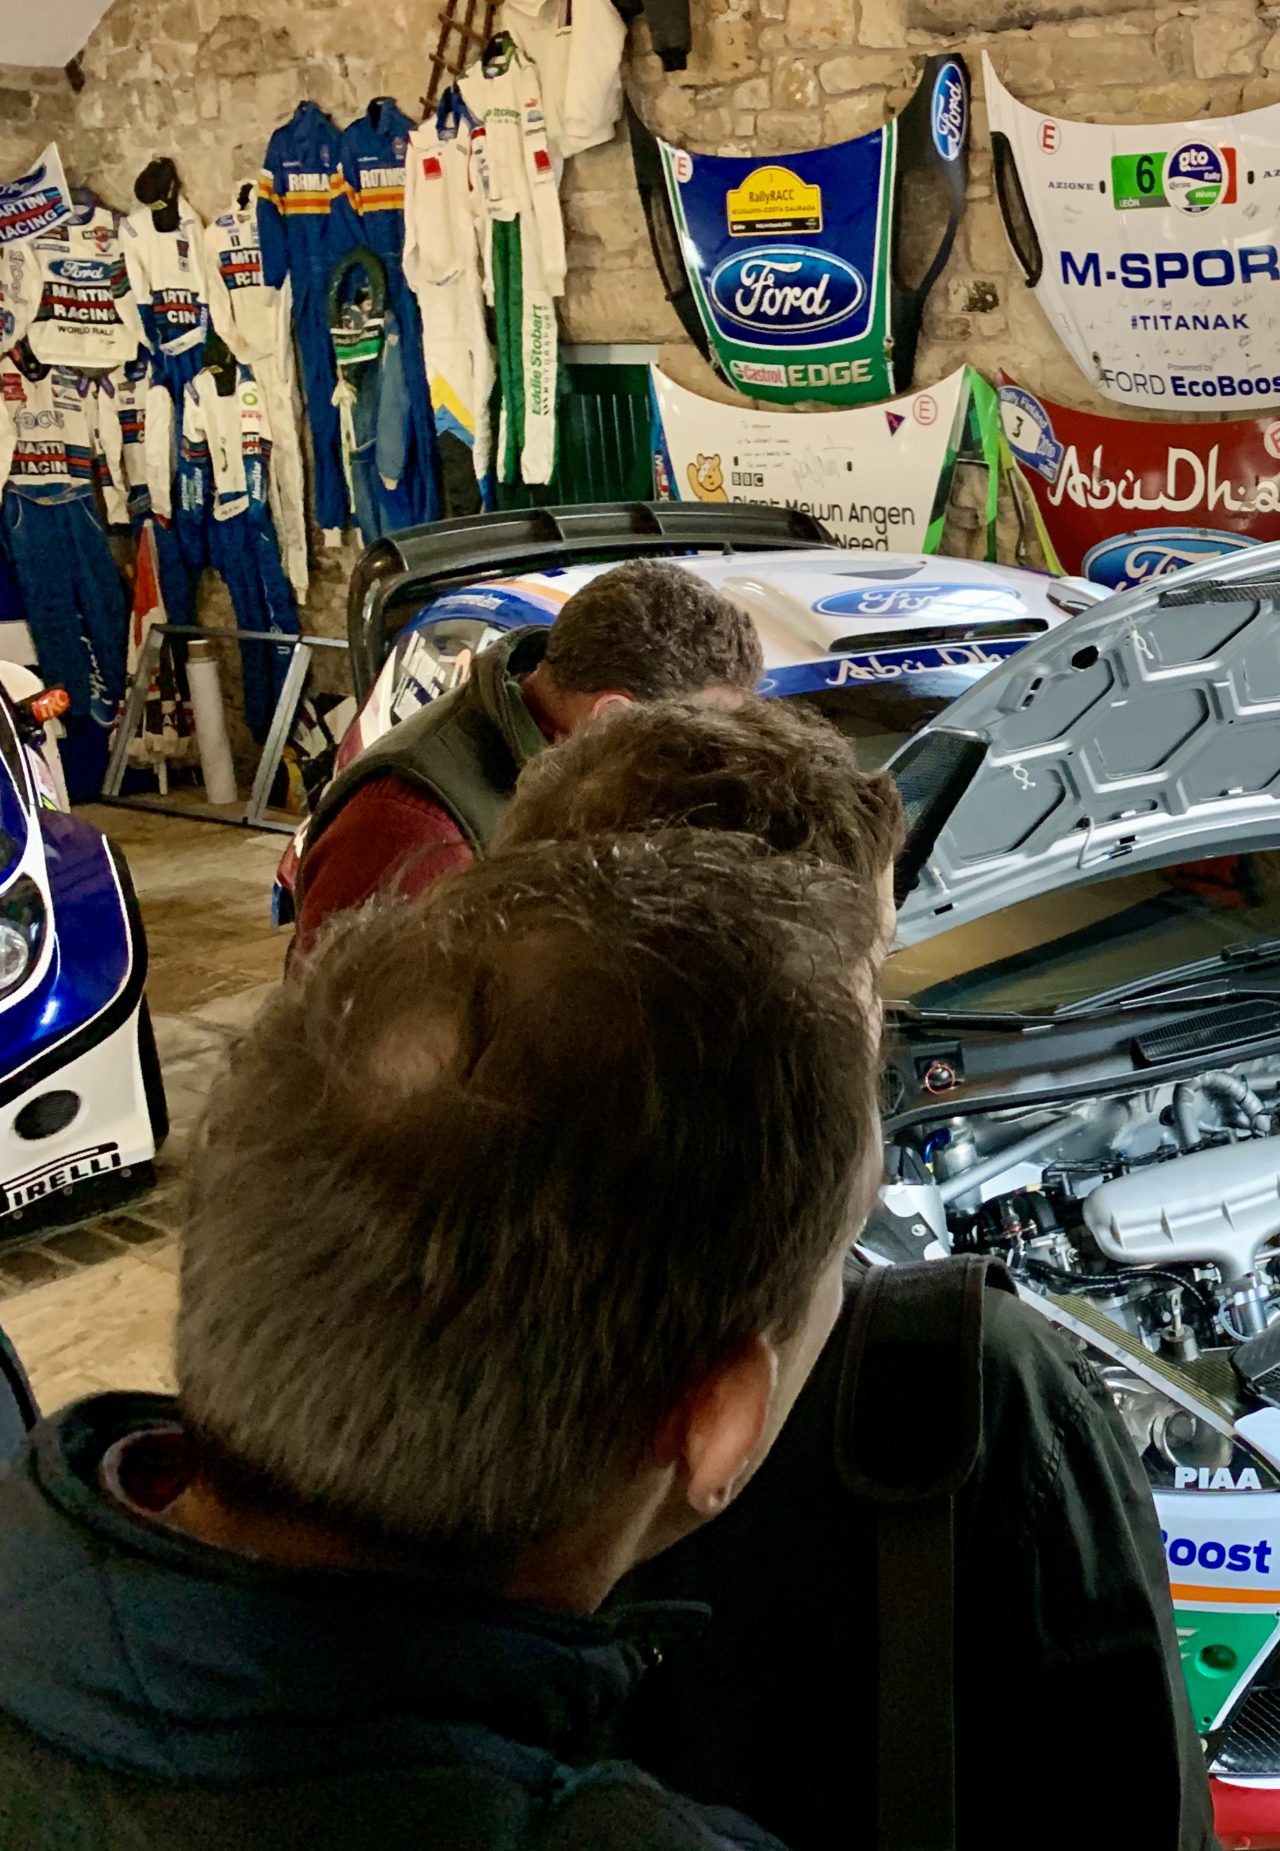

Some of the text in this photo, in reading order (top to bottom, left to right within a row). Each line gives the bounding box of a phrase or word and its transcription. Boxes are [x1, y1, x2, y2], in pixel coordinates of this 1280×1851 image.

[937, 80, 962, 143] Ford
[1042, 124, 1056, 150] E
[1179, 149, 1209, 172] gto
[1048, 181, 1095, 191] AZIONE
[1136, 155, 1155, 194] 6
[0, 191, 48, 218] ARTINI
[60, 261, 105, 279] Ford
[52, 284, 114, 301] MARTIN
[735, 259, 831, 317] Ford
[1131, 313, 1249, 330] #TITANAK
[531, 303, 543, 416] Eddie Stobart
[788, 358, 874, 387] EDGE
[1103, 369, 1166, 395] FORD
[918, 401, 931, 420] E
[1012, 416, 1024, 438] 3
[849, 503, 915, 535] Angen
[1174, 1466, 1262, 1490] PIAA
